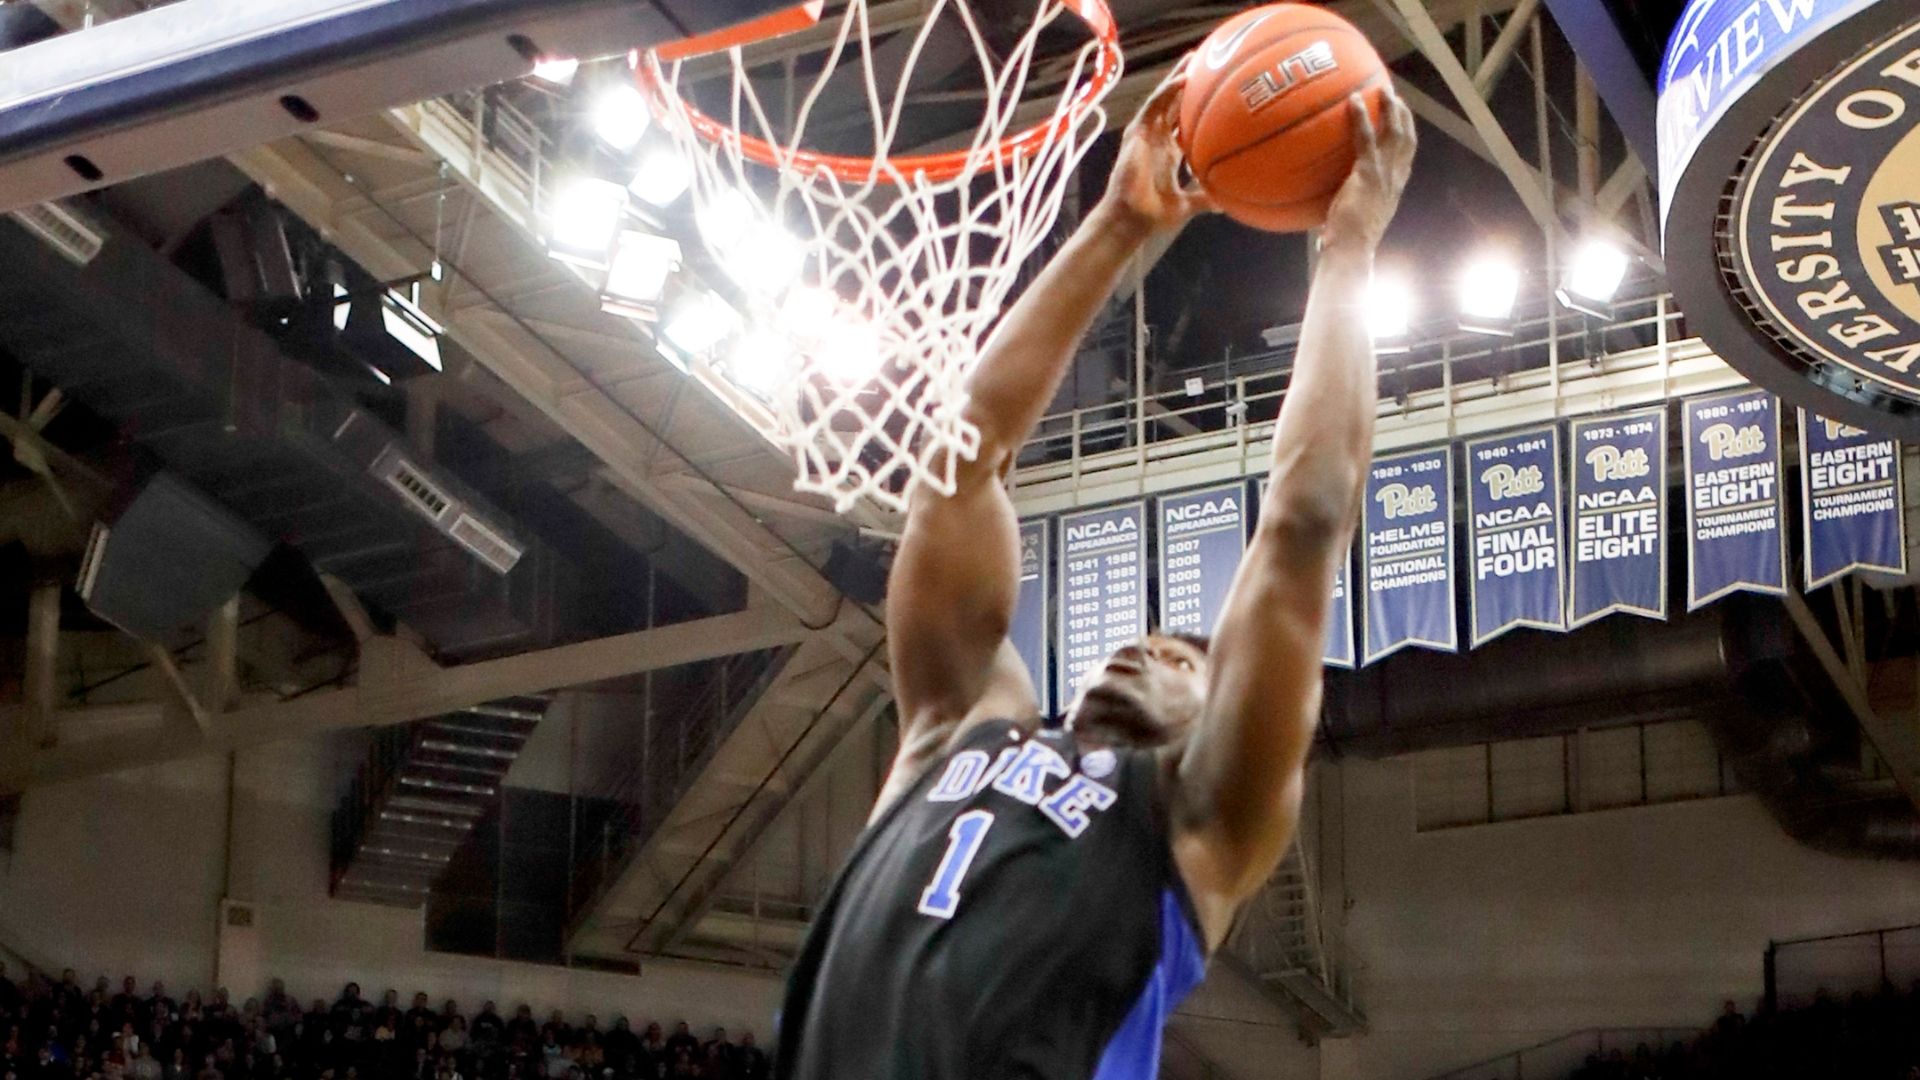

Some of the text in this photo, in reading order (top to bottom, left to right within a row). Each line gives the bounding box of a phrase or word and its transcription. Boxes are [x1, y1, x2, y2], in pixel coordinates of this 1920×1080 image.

[1771, 151, 1920, 378] VERSITY
[1696, 406, 1729, 420] 1980
[1737, 398, 1768, 413] 1981
[1583, 427, 1614, 441] 1973
[1623, 422, 1653, 436] 1974
[1700, 423, 1767, 461] Pitt
[1477, 446, 1508, 461] 1940
[1517, 439, 1546, 453] 1941
[1810, 441, 1893, 467] EASTERN
[1372, 466, 1402, 480] 1929
[1411, 459, 1441, 473] 1930
[1585, 445, 1650, 482] Pitt
[1694, 461, 1775, 488] EASTERN
[1811, 457, 1893, 489] EIGHT
[1481, 464, 1544, 501] Pitt
[1695, 477, 1775, 509] EIGHT
[1375, 483, 1438, 520] Pitt
[1578, 486, 1657, 510] NCAA
[1813, 486, 1893, 509] TOURNAMENT
[1166, 497, 1238, 522] NCAA
[1476, 502, 1553, 529] NCAA
[1696, 506, 1776, 528] TOURNAMENT
[1813, 499, 1894, 521] CHAMPIONS
[1067, 517, 1137, 541] NCAA
[1167, 512, 1239, 534] APPEARANCES
[1369, 521, 1445, 545] HELMS
[1578, 509, 1657, 540] ELITE
[1697, 517, 1776, 540] CHAMPIONS
[1067, 531, 1138, 552] APPEARANCES
[1167, 540, 1199, 554] 2007
[1370, 535, 1445, 557] FOUNDATION
[1477, 525, 1555, 557] FINAL
[1578, 533, 1657, 562] EIGHT
[1068, 558, 1099, 572] 1941
[1168, 554, 1200, 569] 2008
[1370, 556, 1446, 579] NATIONAL
[1477, 546, 1555, 580] FOUR
[1068, 566, 1136, 586] 1957 1989
[1168, 569, 1200, 583] 2009
[1370, 569, 1446, 592] CHAMPIONS
[1068, 580, 1136, 601] 1958 1991
[1168, 583, 1201, 598] 2010
[1068, 595, 1136, 615] 1963 1993
[1169, 598, 1200, 612] 2011
[1068, 609, 1137, 629] 1974 2002
[1169, 612, 1201, 627] 2013
[1068, 623, 1137, 644] 1981 2003
[918, 809, 995, 919] 1
